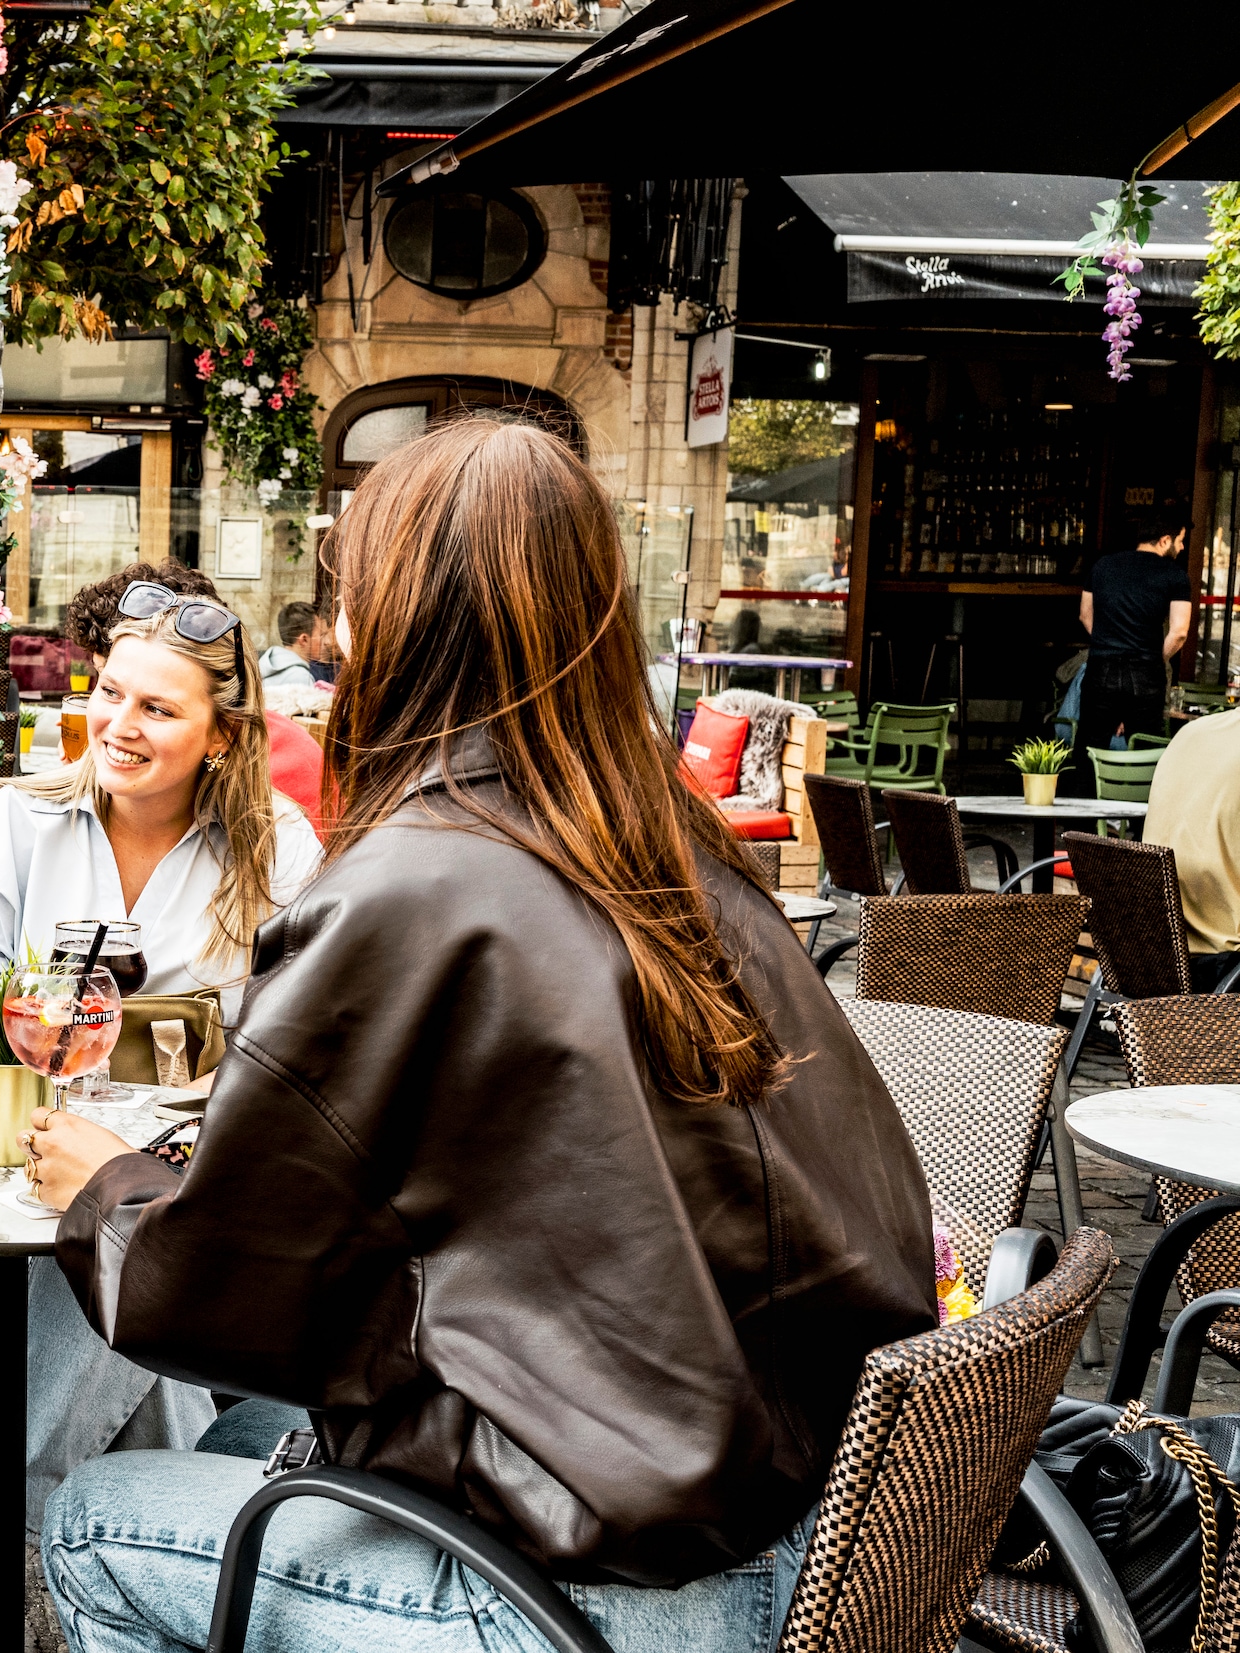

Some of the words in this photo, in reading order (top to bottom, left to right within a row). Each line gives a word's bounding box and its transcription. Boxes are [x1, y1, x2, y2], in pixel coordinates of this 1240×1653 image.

[905, 255, 950, 275] Stella
[699, 379, 720, 393] STELLA
[698, 395, 720, 409] ARTOIS
[74, 1011, 112, 1024] MARTINI
